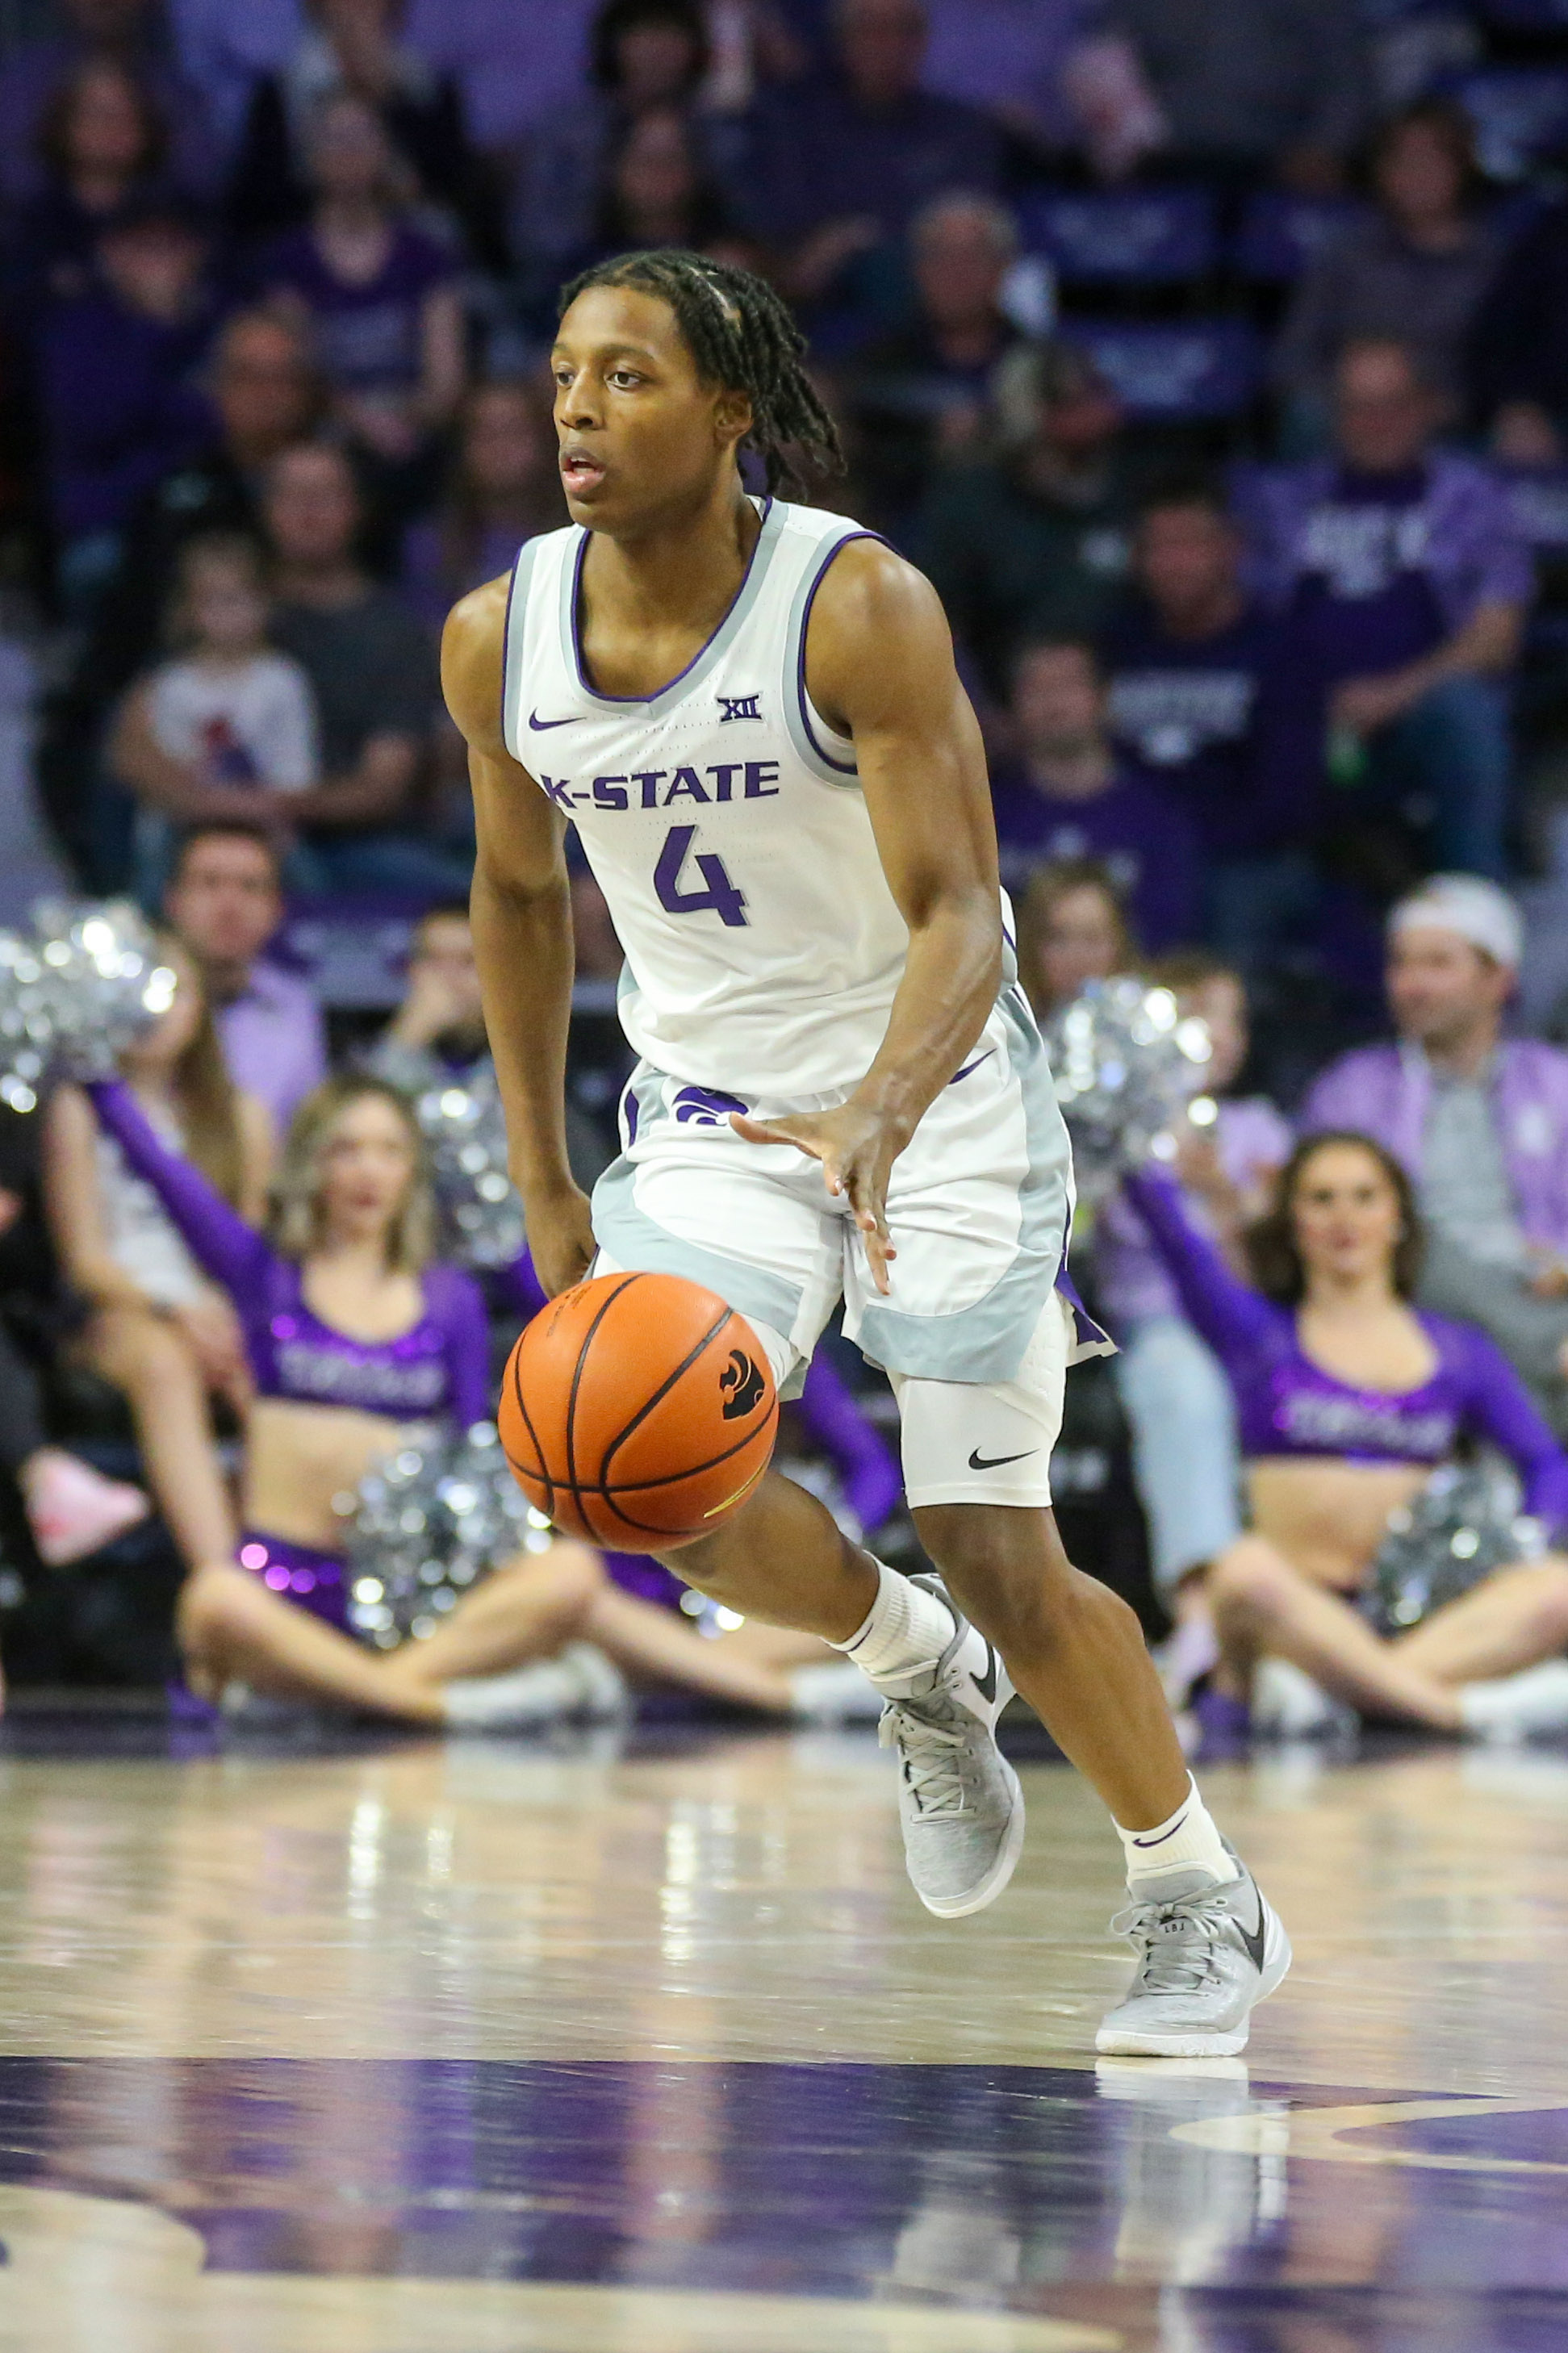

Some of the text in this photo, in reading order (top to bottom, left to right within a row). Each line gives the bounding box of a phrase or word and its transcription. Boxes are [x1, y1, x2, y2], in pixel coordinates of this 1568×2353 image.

[717, 693, 763, 722] XII
[540, 761, 780, 810] K-STATE
[654, 825, 749, 927] 4
[1165, 1922, 1185, 1933] LBJ
